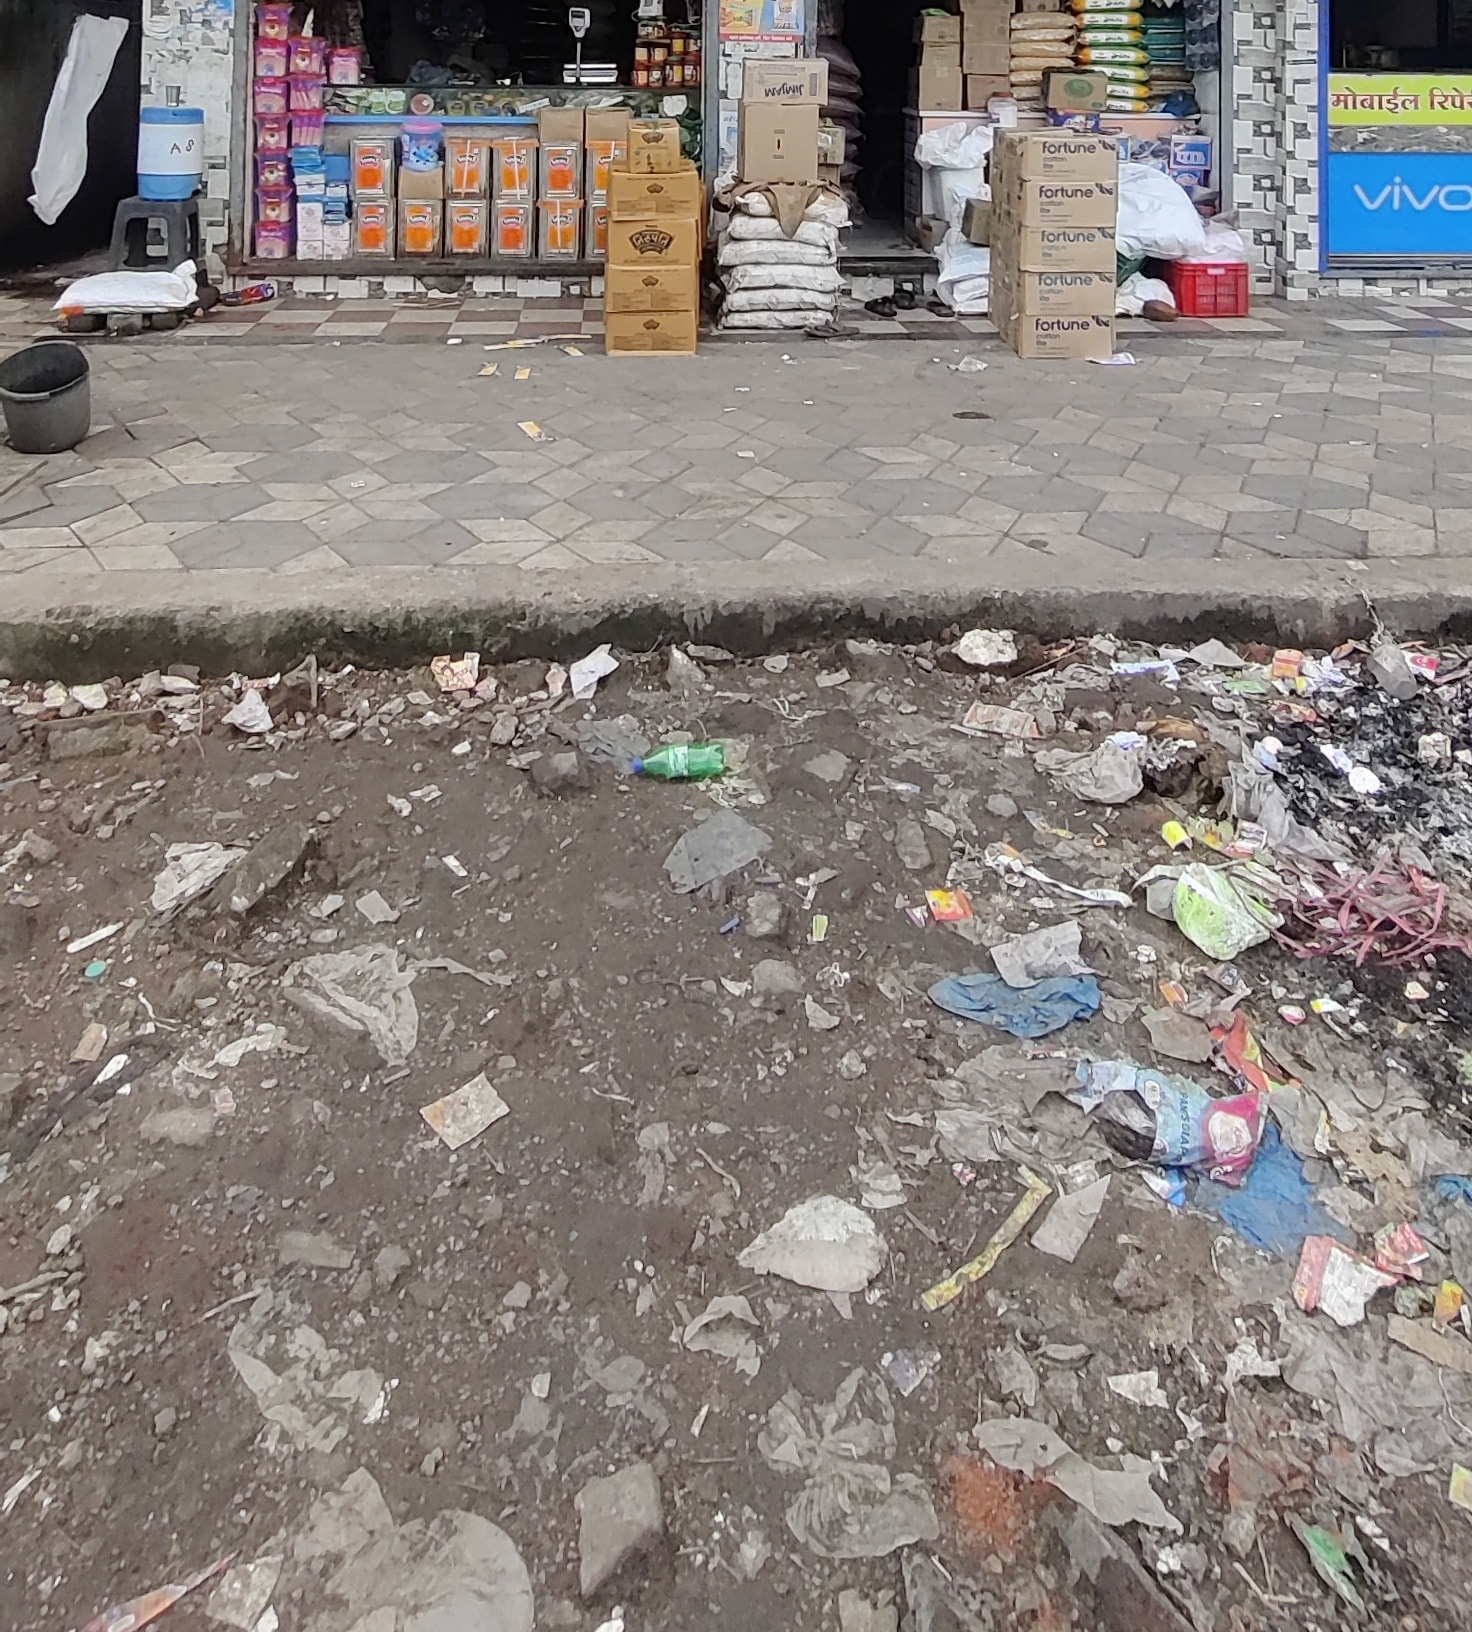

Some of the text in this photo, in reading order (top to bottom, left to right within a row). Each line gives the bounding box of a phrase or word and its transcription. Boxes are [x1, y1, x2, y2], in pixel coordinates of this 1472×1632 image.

[1331, 86, 1421, 114] मोबाईल
[1042, 140, 1096, 154] fortune
[1039, 185, 1094, 199] fortune
[1353, 175, 1472, 211] vivo
[1041, 230, 1096, 243] fortune
[1038, 273, 1093, 287] fortune
[1035, 318, 1090, 332] fortune
